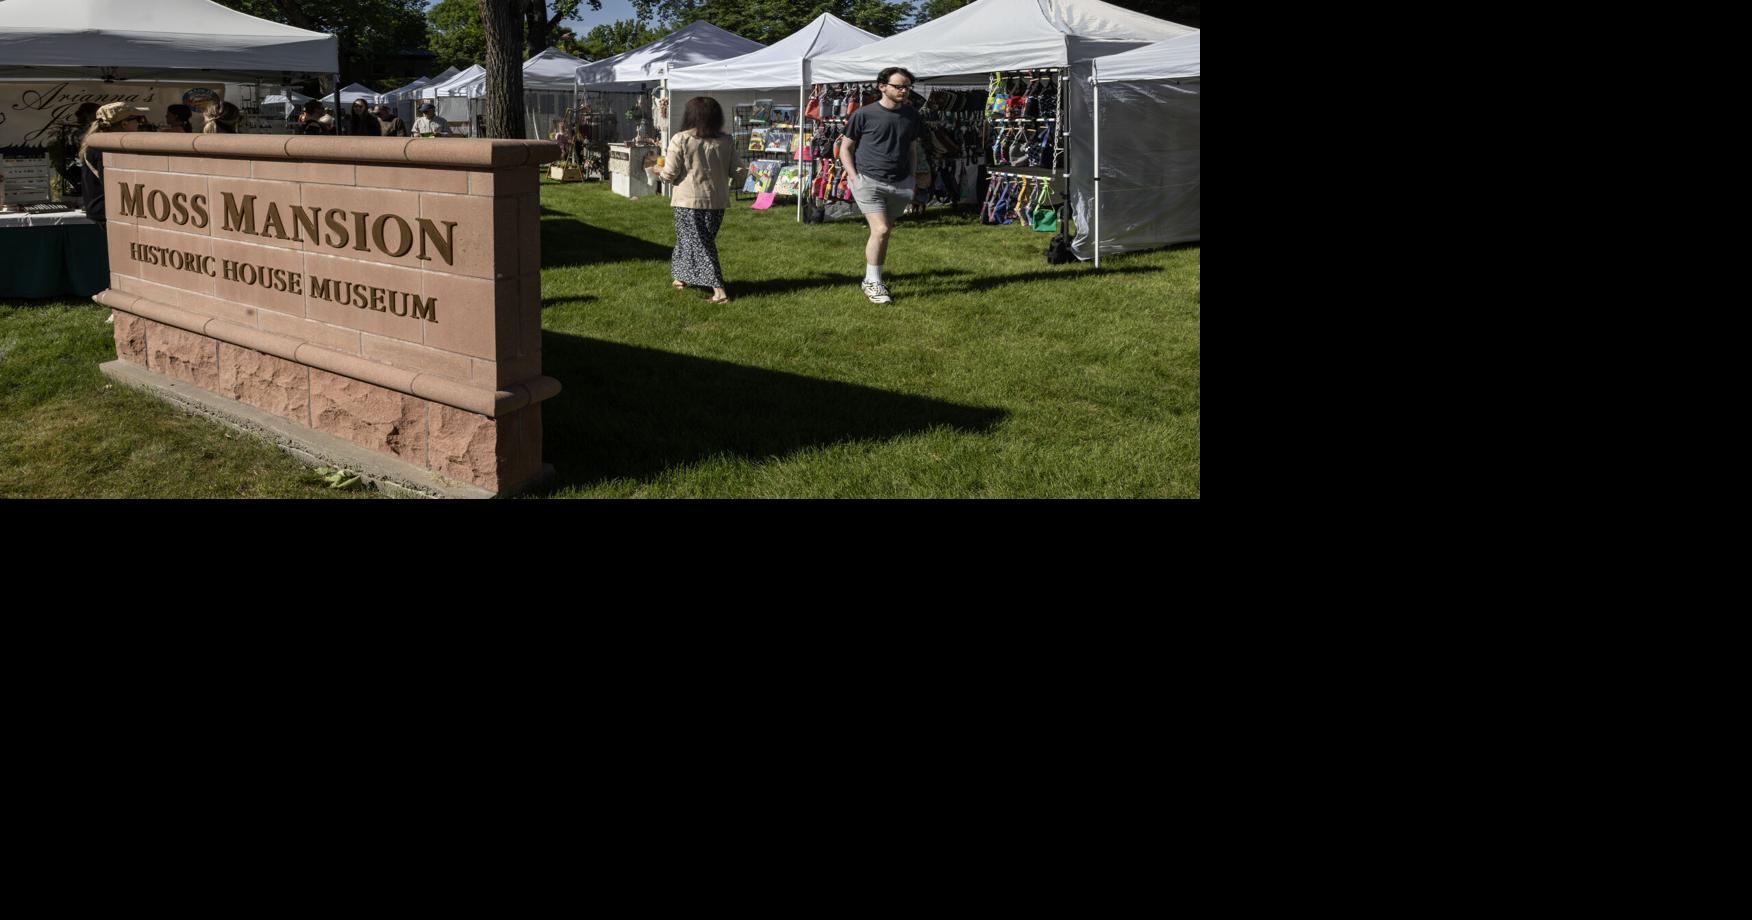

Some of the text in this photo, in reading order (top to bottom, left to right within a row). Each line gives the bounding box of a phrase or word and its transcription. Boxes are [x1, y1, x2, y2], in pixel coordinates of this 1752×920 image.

[12, 82, 155, 110] Arianna's
[118, 181, 457, 266] MOSS MANSION
[130, 243, 438, 323] HISTORIC HOUSE MUSEUM
